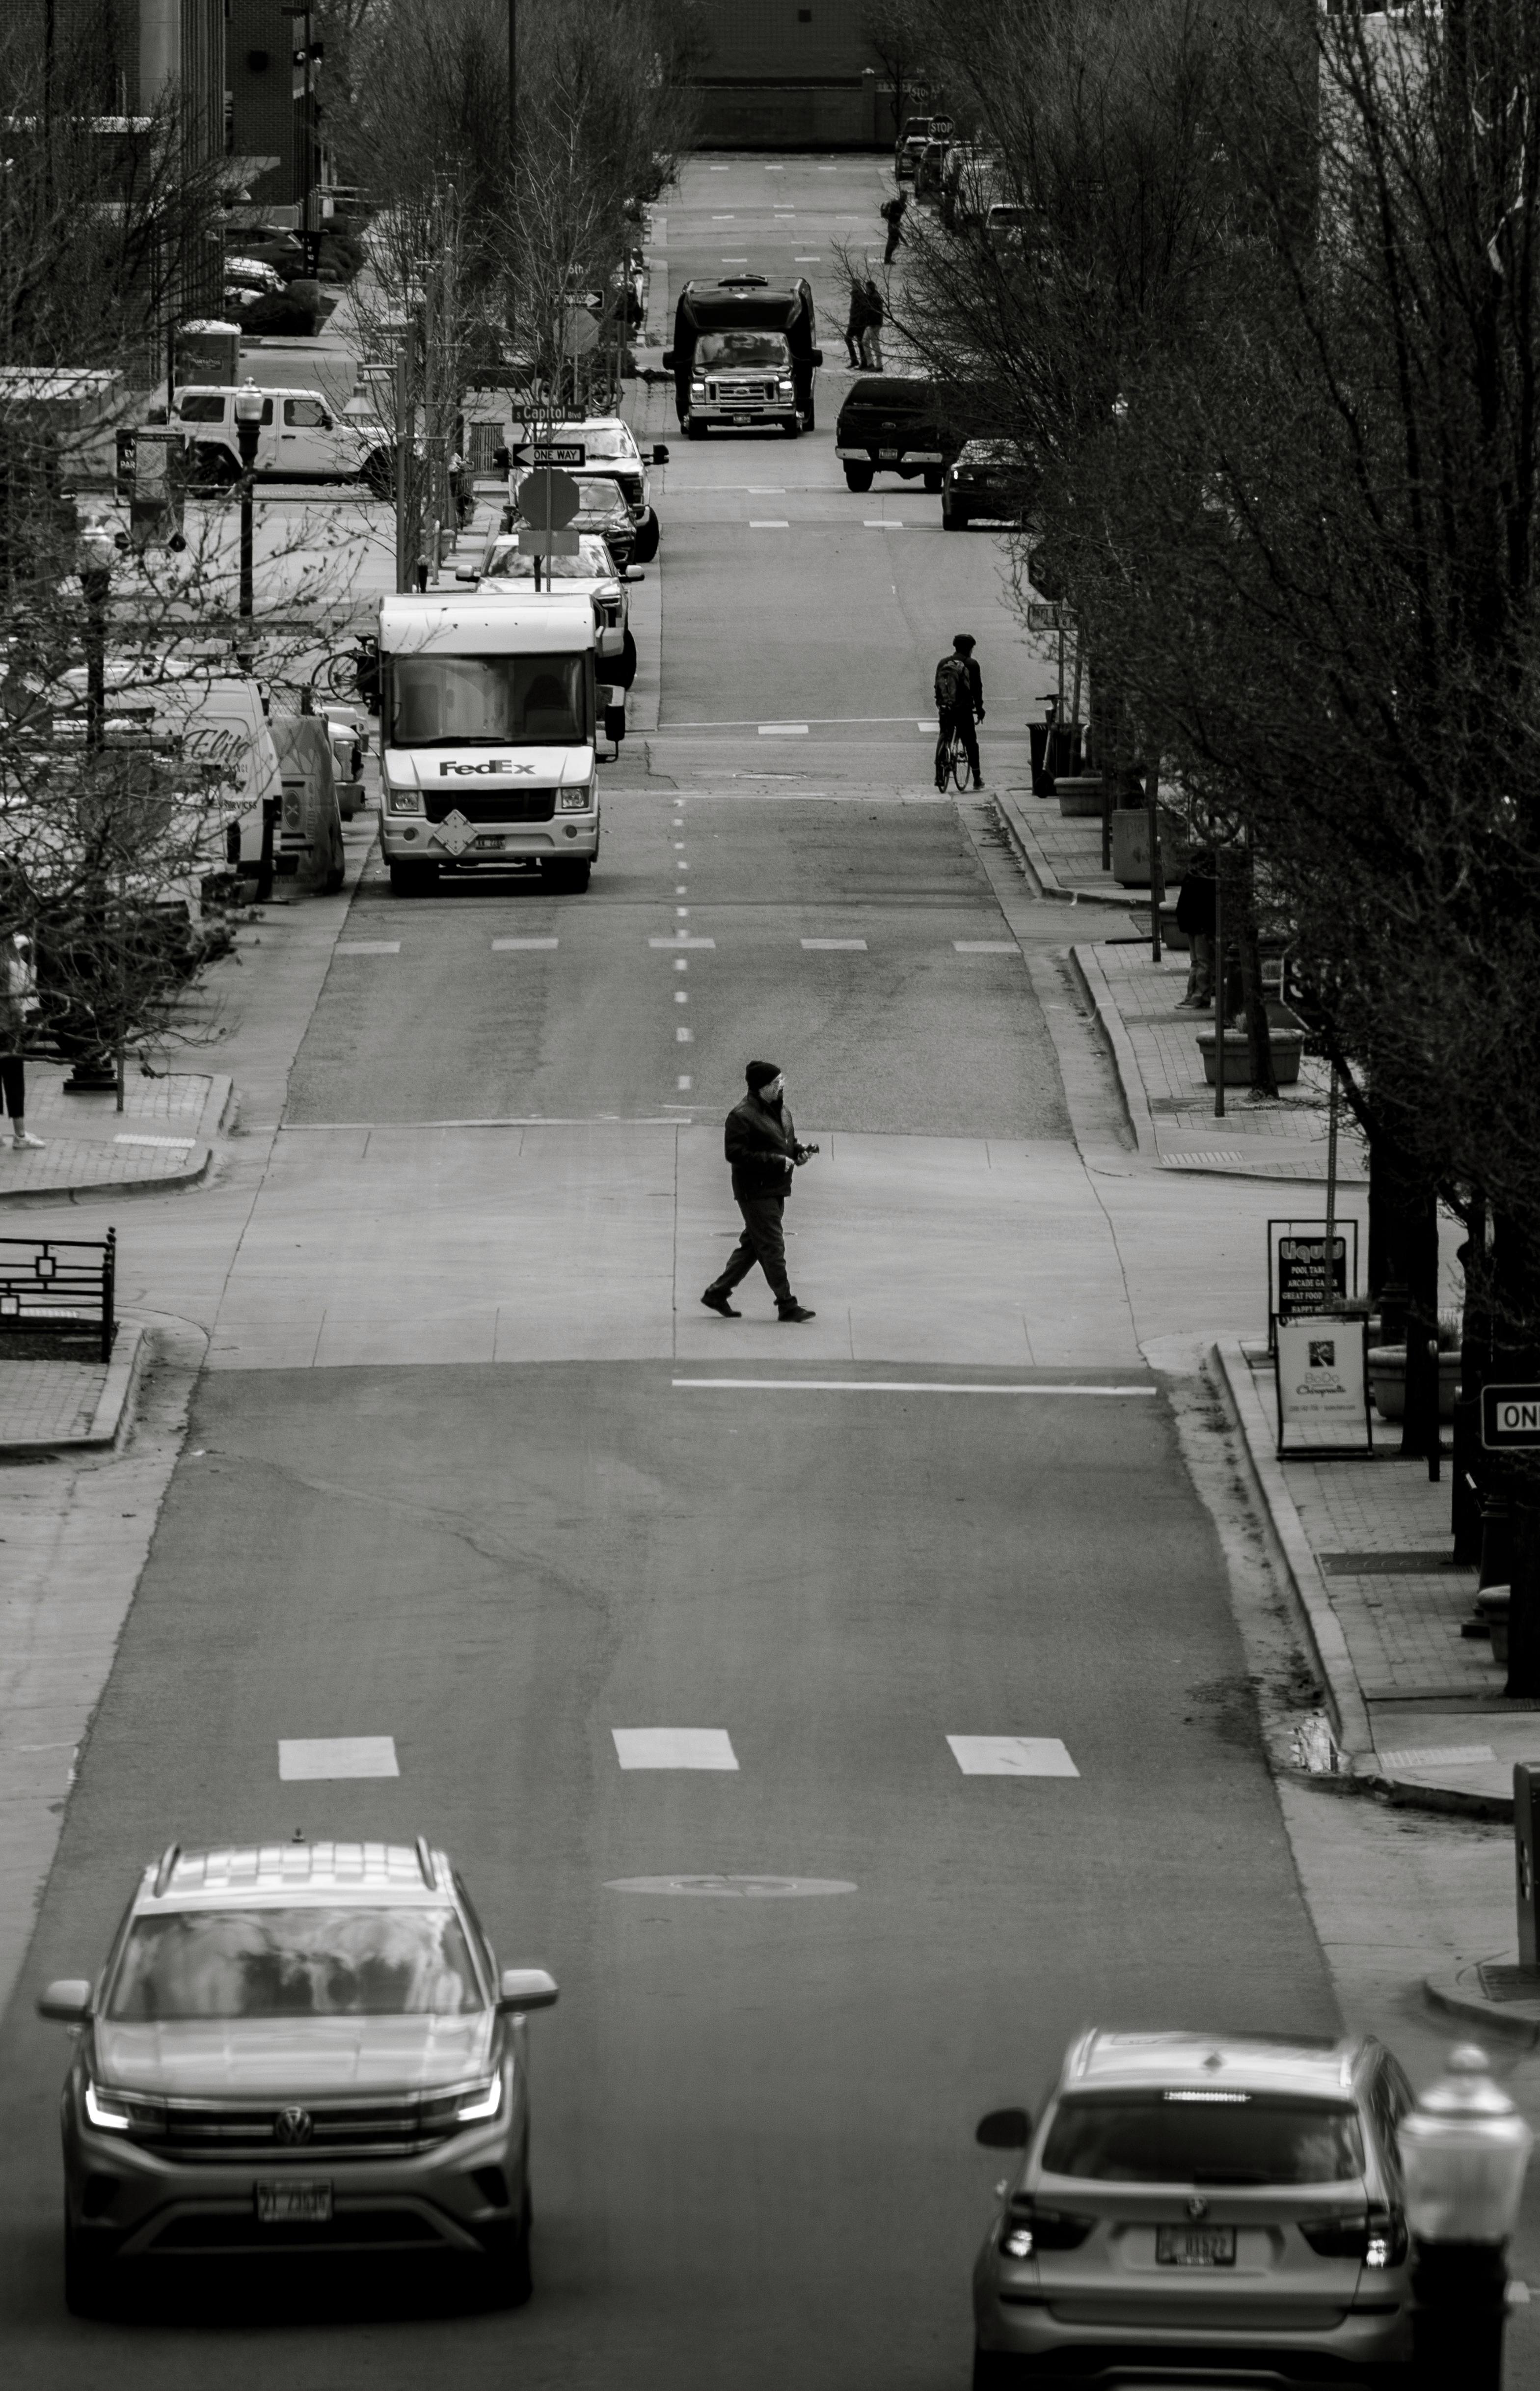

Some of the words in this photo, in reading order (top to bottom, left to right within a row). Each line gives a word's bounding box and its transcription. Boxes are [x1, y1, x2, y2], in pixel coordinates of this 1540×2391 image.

[930, 122, 953, 134] STOP
[523, 406, 565, 421] Capitol
[534, 450, 553, 460] ONE
[557, 450, 577, 460] WAY
[439, 760, 537, 776] FedEx
[1281, 1240, 1344, 1264] Liquid
[1291, 1266, 1308, 1274] POOL
[1288, 1279, 1314, 1287] ARCADE
[1505, 1405, 1540, 1428] ON
